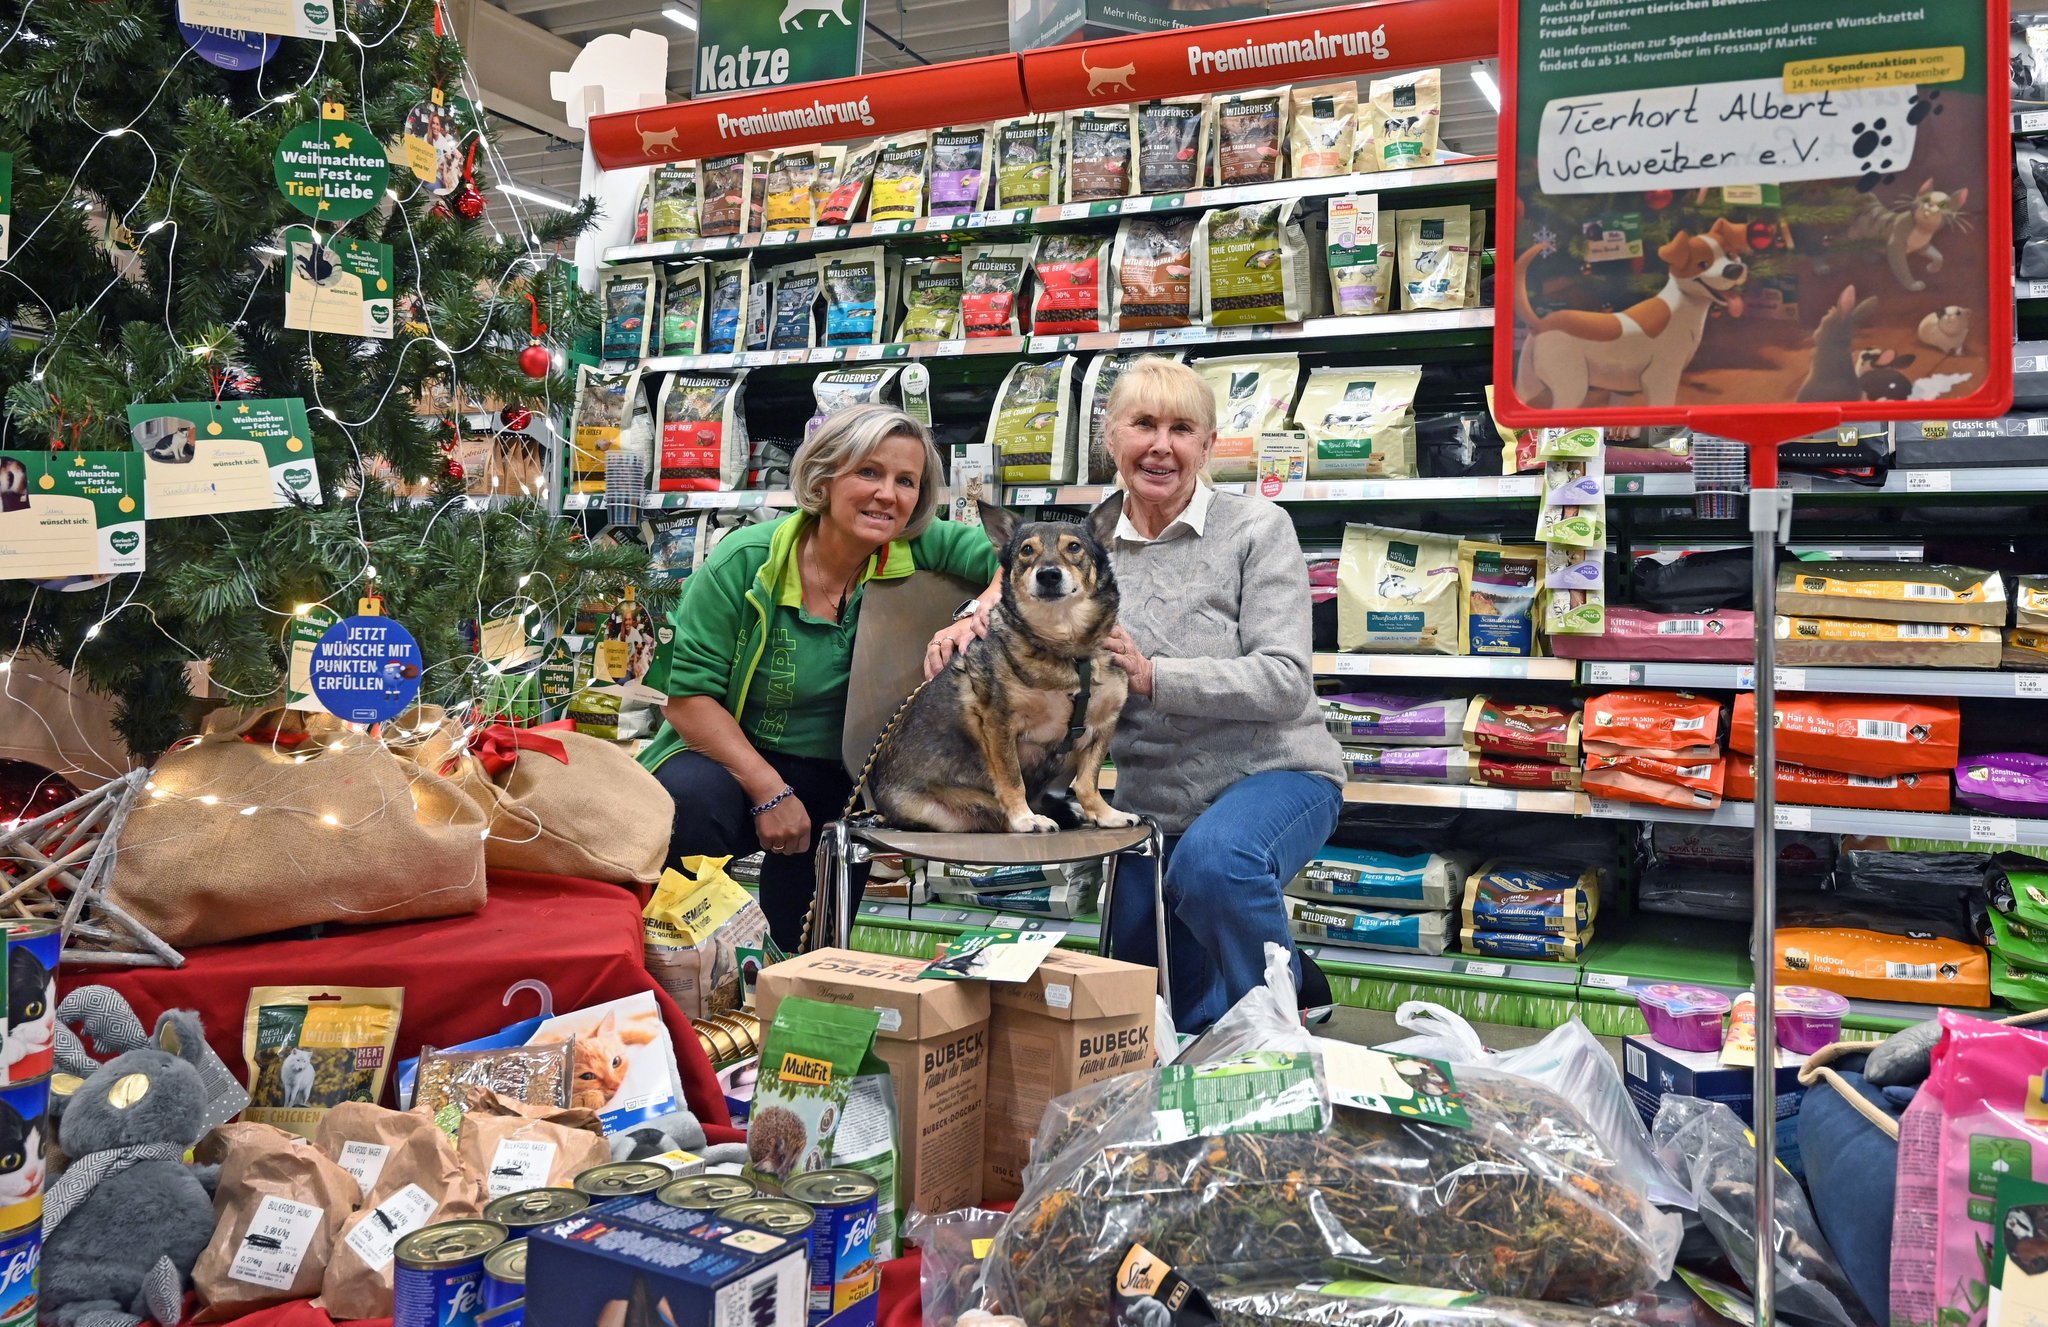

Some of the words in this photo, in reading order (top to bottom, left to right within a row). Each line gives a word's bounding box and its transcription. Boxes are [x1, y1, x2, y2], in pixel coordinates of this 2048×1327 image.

[1540, 3, 1567, 14] Auch
[1570, 1, 1583, 11] du
[1540, 11, 1596, 26] Fressnapf
[1598, 7, 1645, 20] unseren
[1647, 1, 1709, 15] tierischen
[1103, 6, 1125, 19] Mehr
[1127, 11, 1148, 23] Infos
[1149, 17, 1171, 28] unter
[1539, 48, 1561, 59] Alle
[1563, 41, 1645, 57] Informationen
[1647, 38, 1667, 48] zur
[1669, 27, 1762, 46] Spendenaktion
[1765, 23, 1788, 35] und
[1791, 19, 1833, 33] unsere
[1836, 8, 1925, 28] Wunschzettel
[1540, 26, 1578, 39] Freude
[1581, 21, 1630, 35] bereiten.
[1188, 24, 1390, 76] Premiumnahrung
[1540, 60, 1578, 72] findest
[1581, 57, 1595, 69] du
[1598, 55, 1612, 67] ab
[1615, 54, 1631, 65] 14.
[1634, 47, 1692, 63] November
[1696, 46, 1711, 57] im
[1714, 39, 1772, 56] Fressnapf
[1775, 35, 1817, 49] Markt:
[701, 45, 789, 92] Katze
[1792, 66, 1824, 77] Große
[1827, 57, 1917, 74] Spendenaktion
[1920, 54, 1944, 64] vom
[1792, 80, 1806, 89] 14.
[1894, 67, 1951, 81] Dezember
[1146, 109, 1194, 118] WILDERNESS
[1226, 103, 1273, 116] WILDERNESS
[1556, 87, 1700, 138] Tierhort
[1719, 89, 1839, 122] Albert
[717, 95, 876, 139] Premiumnahrung
[1080, 122, 1127, 133] WILDERNESS
[302, 140, 330, 150] Mach
[936, 136, 979, 145] WILDERNESS
[282, 151, 385, 168] Weihnachten
[294, 171, 317, 179] zum
[319, 168, 352, 181] Fest
[354, 172, 372, 182] der
[286, 181, 374, 199] TierLiebe
[1356, 225, 1372, 235] 5%
[1211, 246, 1225, 255] TRUE
[1227, 243, 1255, 253] COUNTRY
[971, 262, 1016, 272] WILDERNESS
[1125, 257, 1141, 266] WIDE
[827, 267, 868, 278] WILDERNESS
[918, 278, 959, 289] WILDERNESS
[1237, 275, 1253, 284] 25%
[611, 283, 643, 293] WILDERNESS
[1174, 285, 1187, 293] 0%
[679, 376, 730, 388] WILDERNESS
[828, 372, 880, 383] WILDERNESS
[1952, 421, 1984, 430] Classic
[1986, 421, 1999, 429] Fit
[249, 429, 288, 437] TierLiebe
[67, 470, 120, 478] Weihnachten
[82, 486, 122, 494] TierLiebe
[1610, 618, 1635, 626] Kitten
[1825, 620, 1850, 628] Maine
[348, 627, 387, 640] JETZT
[322, 641, 385, 657] WÜNSCHE
[388, 644, 412, 657] MIT
[316, 660, 377, 673] PUNKTEN
[318, 674, 384, 690] ERFÜLLEN
[543, 683, 570, 695] TierLiebe
[1324, 711, 1371, 722] WILDERNESS
[1616, 715, 1632, 723] Hair
[1787, 713, 1805, 723] Hair
[1808, 715, 1813, 723] &
[1815, 716, 1834, 727] Skin
[1786, 723, 1802, 731] Adult
[1778, 765, 1795, 774] Hair
[1991, 768, 2021, 777] Sensitive
[1777, 774, 1794, 782] Adult
[1306, 871, 1352, 881] WILDERNESS
[1365, 874, 1383, 882] FRESH
[1495, 907, 1545, 916] Scandinavia
[1301, 910, 1346, 927] WILDERNESS
[1359, 917, 1377, 926] FRESH
[1496, 933, 1546, 942] Scandinavia
[1786, 956, 1808, 965] SELECT
[1788, 961, 1806, 970] GOLD
[1814, 954, 1844, 967] Indoor
[1814, 965, 1831, 973] Adult
[262, 1028, 285, 1037] Real
[305, 1031, 375, 1043] WILDERNESS
[260, 1033, 296, 1045] Nature
[1079, 1025, 1149, 1058] BUBECK
[358, 1047, 383, 1058] MEAT
[924, 1030, 984, 1073] BUBECK
[357, 1058, 382, 1068] SNACK
[1108, 1053, 1120, 1068] die
[783, 1056, 828, 1083] MultiFit
[949, 1062, 960, 1080] die
[270, 1111, 321, 1123] CHICKEN
[923, 1099, 982, 1137] BUBECK-DOGCRAFT
[268, 1200, 296, 1215] BULKFOOD
[296, 1207, 312, 1218] HUND
[1971, 1206, 1991, 1215] 16%
[554, 1216, 592, 1239] felix
[1121, 1262, 1155, 1290] Sheba
